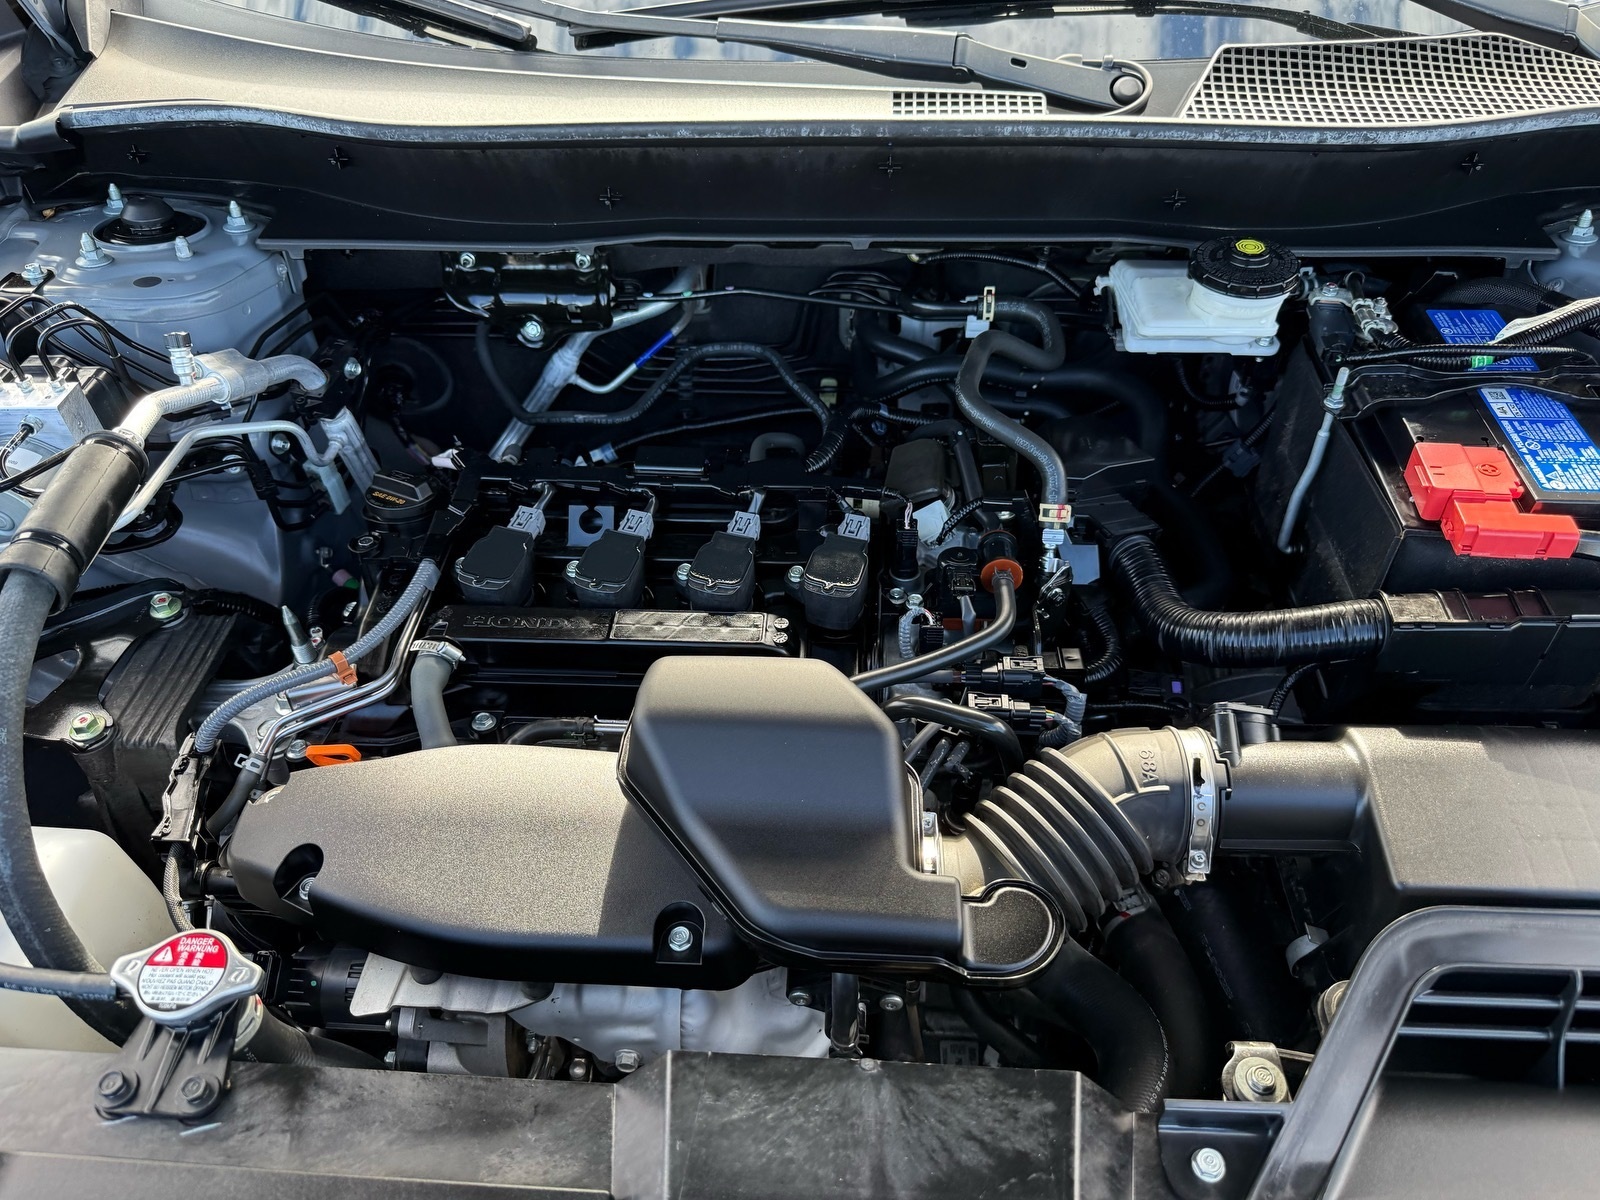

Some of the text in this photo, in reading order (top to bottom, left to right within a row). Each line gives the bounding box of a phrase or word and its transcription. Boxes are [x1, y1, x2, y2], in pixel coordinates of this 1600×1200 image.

[1138, 749, 1159, 786] 68A
[180, 937, 214, 945] DANGER
[177, 945, 219, 953] WARNUNG
